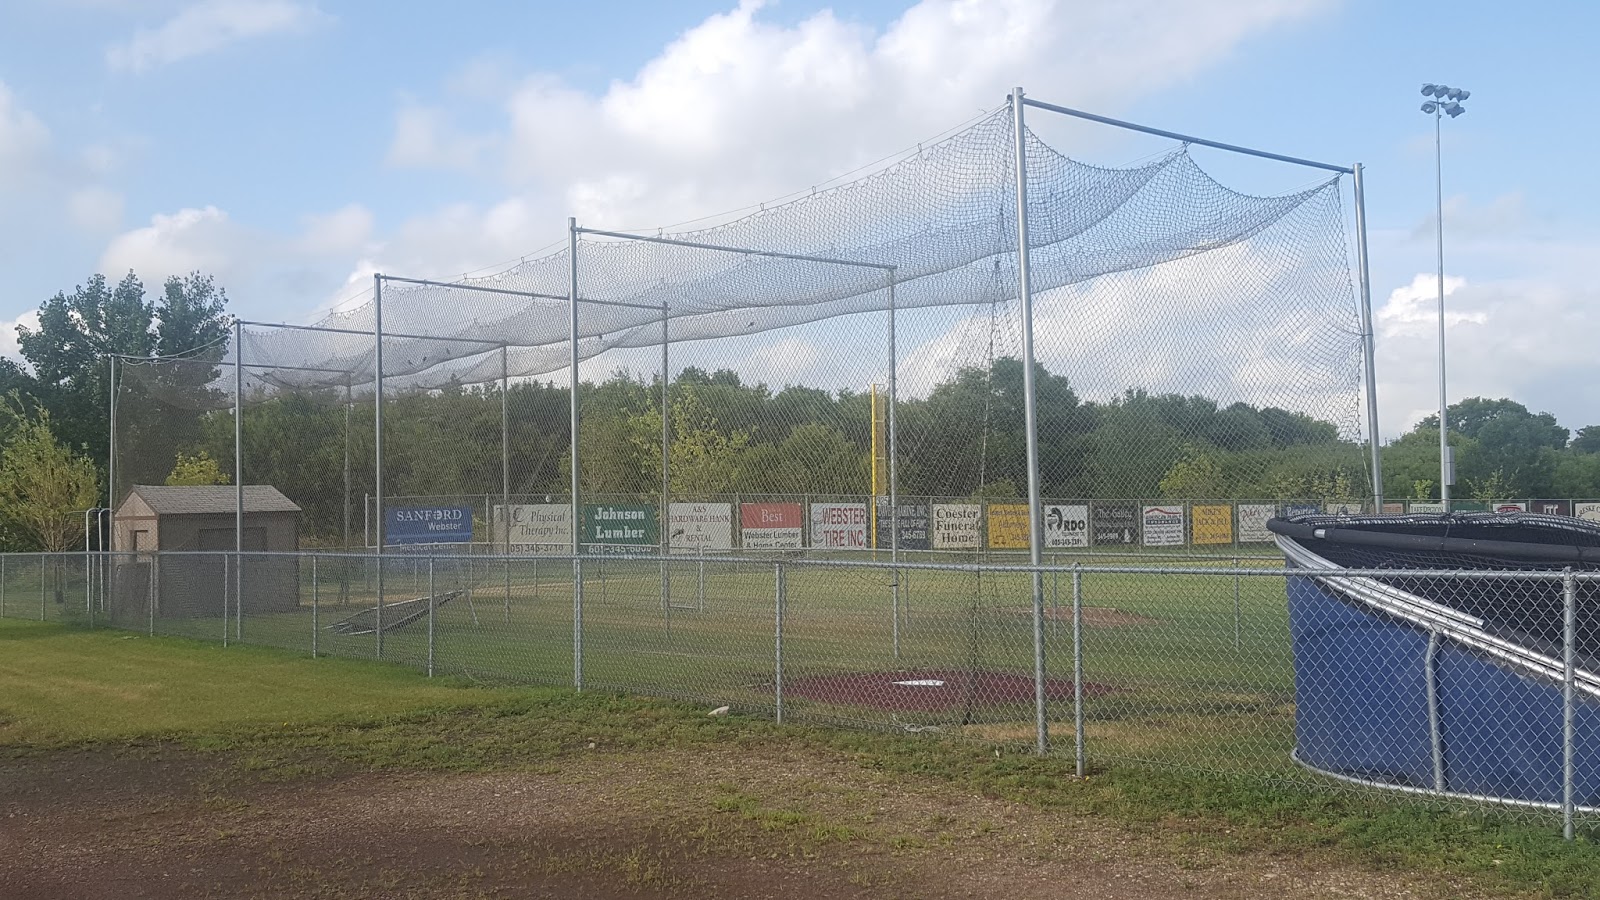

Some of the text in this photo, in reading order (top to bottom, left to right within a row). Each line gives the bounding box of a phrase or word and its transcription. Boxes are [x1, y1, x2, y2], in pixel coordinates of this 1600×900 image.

[396, 509, 463, 521] SANFORD
[531, 509, 568, 523] Physical
[594, 507, 646, 520] Johnson
[761, 508, 784, 523] Best
[822, 507, 866, 525] WEBSTER
[936, 508, 978, 519] Coester
[427, 522, 462, 531] Webster
[519, 523, 554, 537] Therapy
[936, 519, 981, 531] Funeral
[1063, 519, 1086, 531] RDO
[595, 525, 645, 539] Lumber
[744, 531, 773, 540] Webster
[942, 532, 975, 543] Home
[823, 530, 846, 547] TIRE
